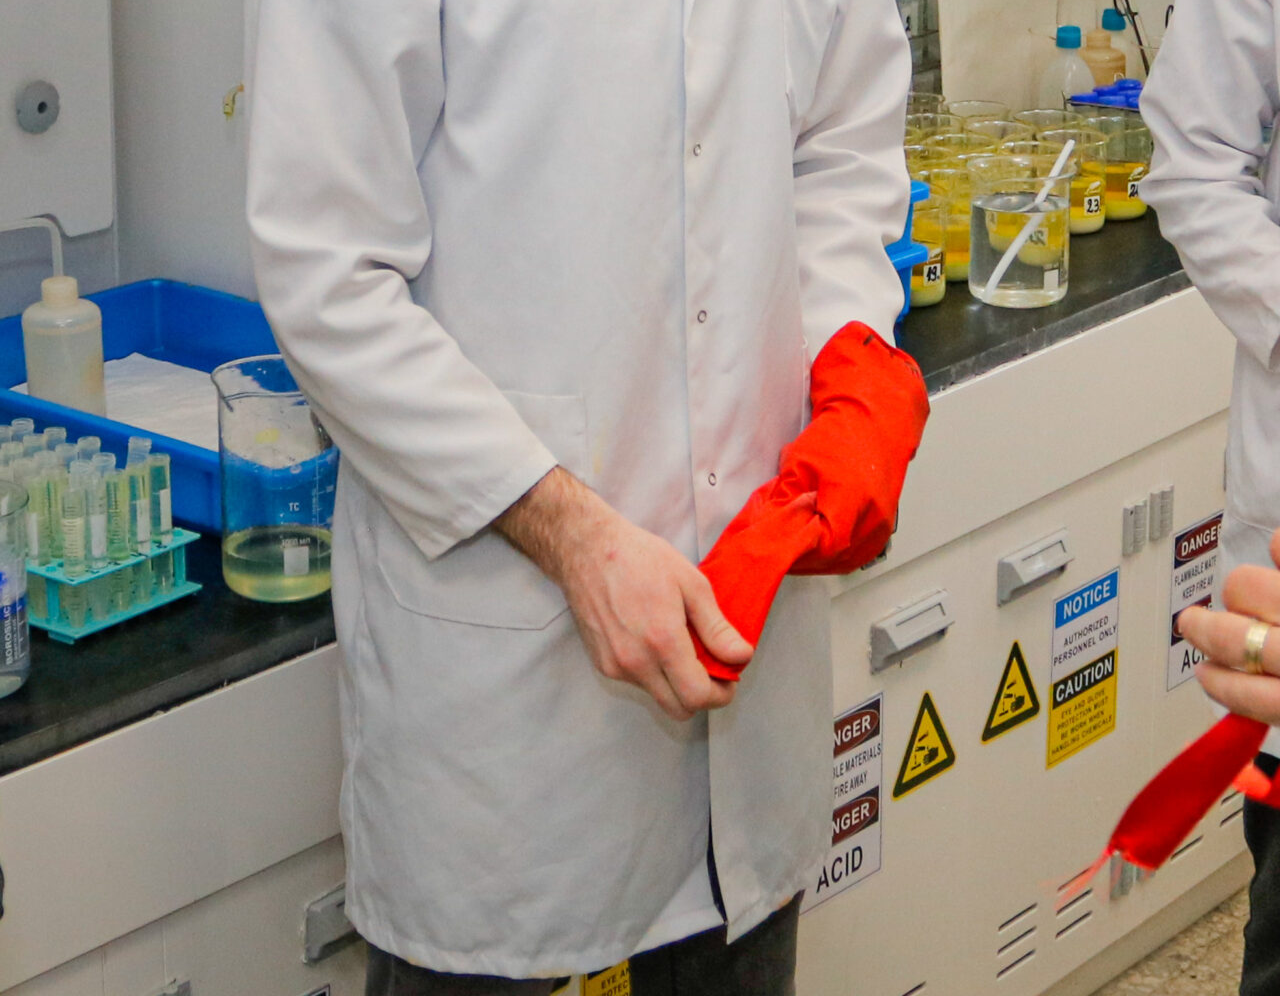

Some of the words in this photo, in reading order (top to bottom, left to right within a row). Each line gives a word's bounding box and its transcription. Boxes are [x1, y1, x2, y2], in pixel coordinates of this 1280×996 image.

[288, 502, 300, 512] TC
[1063, 580, 1111, 620] NOTICE
[1053, 637, 1096, 666] PERSONNEL
[1099, 624, 1117, 641] ONLY
[1063, 615, 1109, 648] AUTHORIZED
[1056, 656, 1113, 702] CAUTION
[1057, 706, 1092, 731] PROTECTION
[845, 743, 882, 772] MATERIALS
[834, 782, 849, 798] FIRE
[849, 771, 868, 792] AWAY
[816, 845, 863, 894] ACID
[601, 974, 617, 989] EYE
